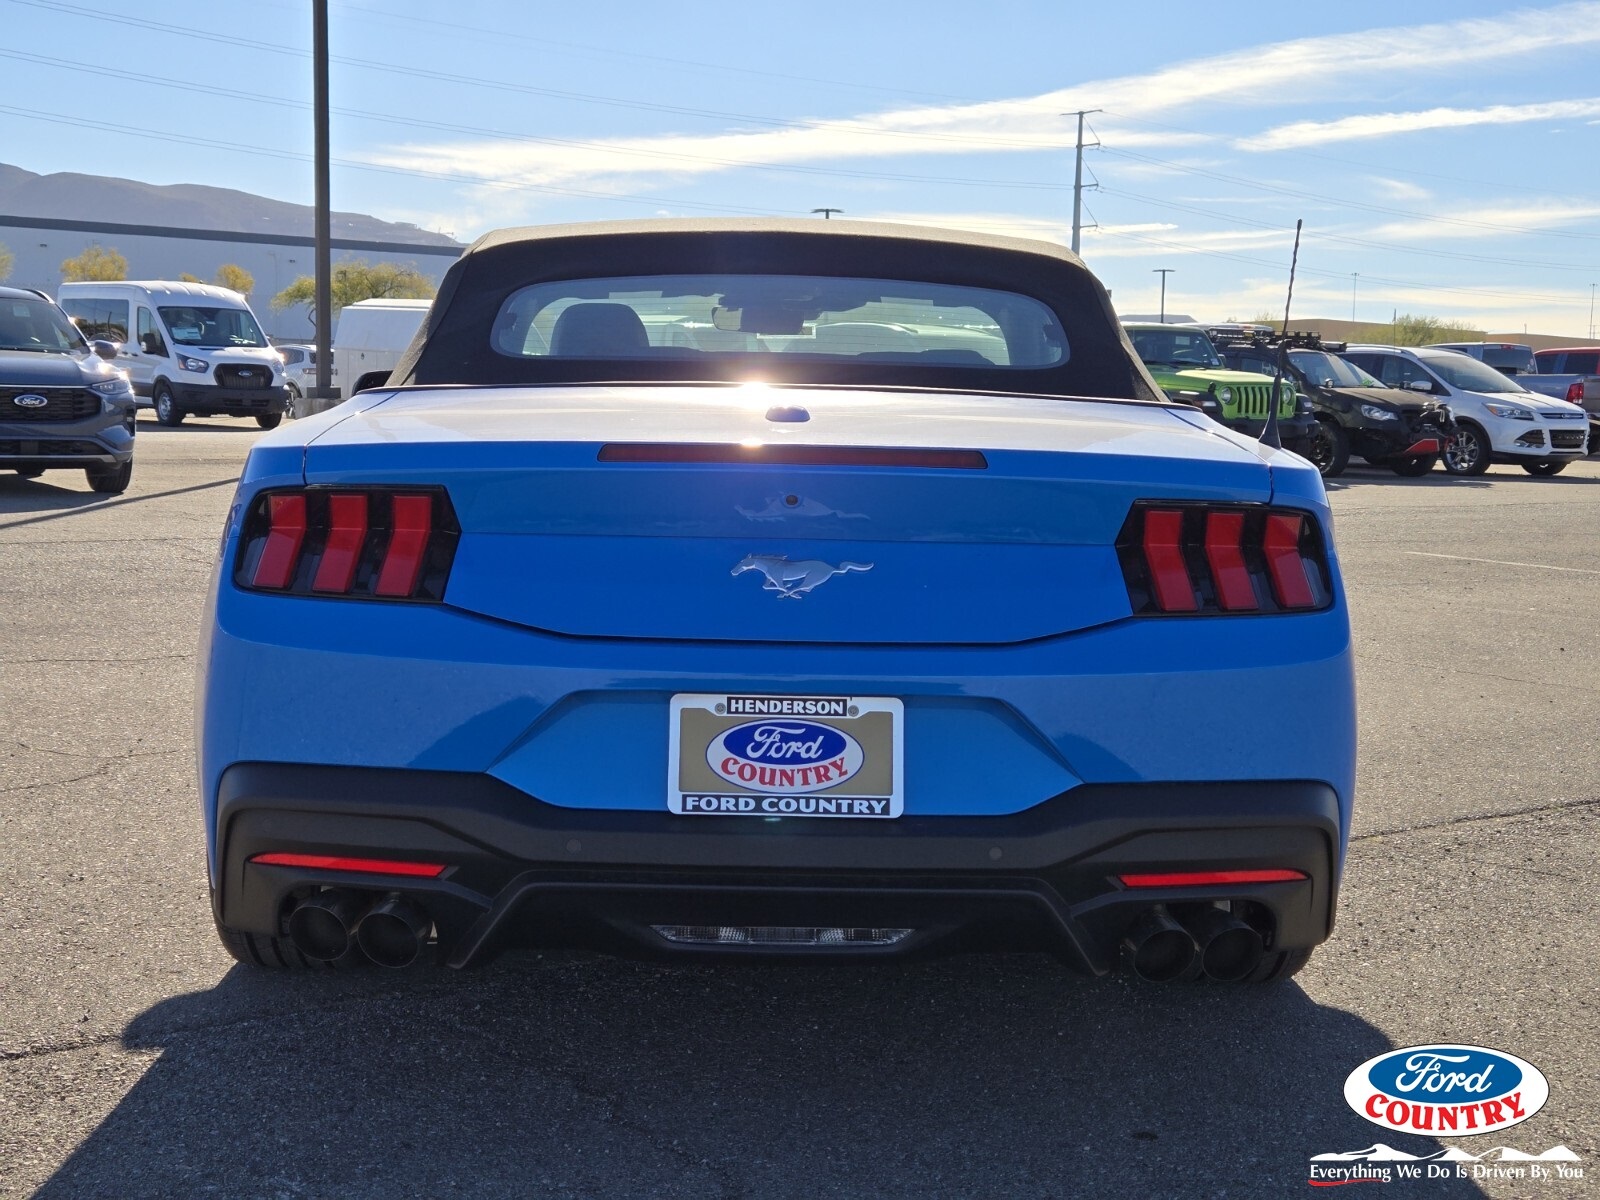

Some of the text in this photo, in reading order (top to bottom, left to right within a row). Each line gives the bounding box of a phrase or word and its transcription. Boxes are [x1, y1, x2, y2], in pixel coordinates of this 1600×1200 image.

[730, 699, 844, 715] HENDERSON
[746, 725, 825, 759] Ford
[721, 757, 849, 787] COUNTRY
[685, 796, 887, 814] FORD COUNTRY
